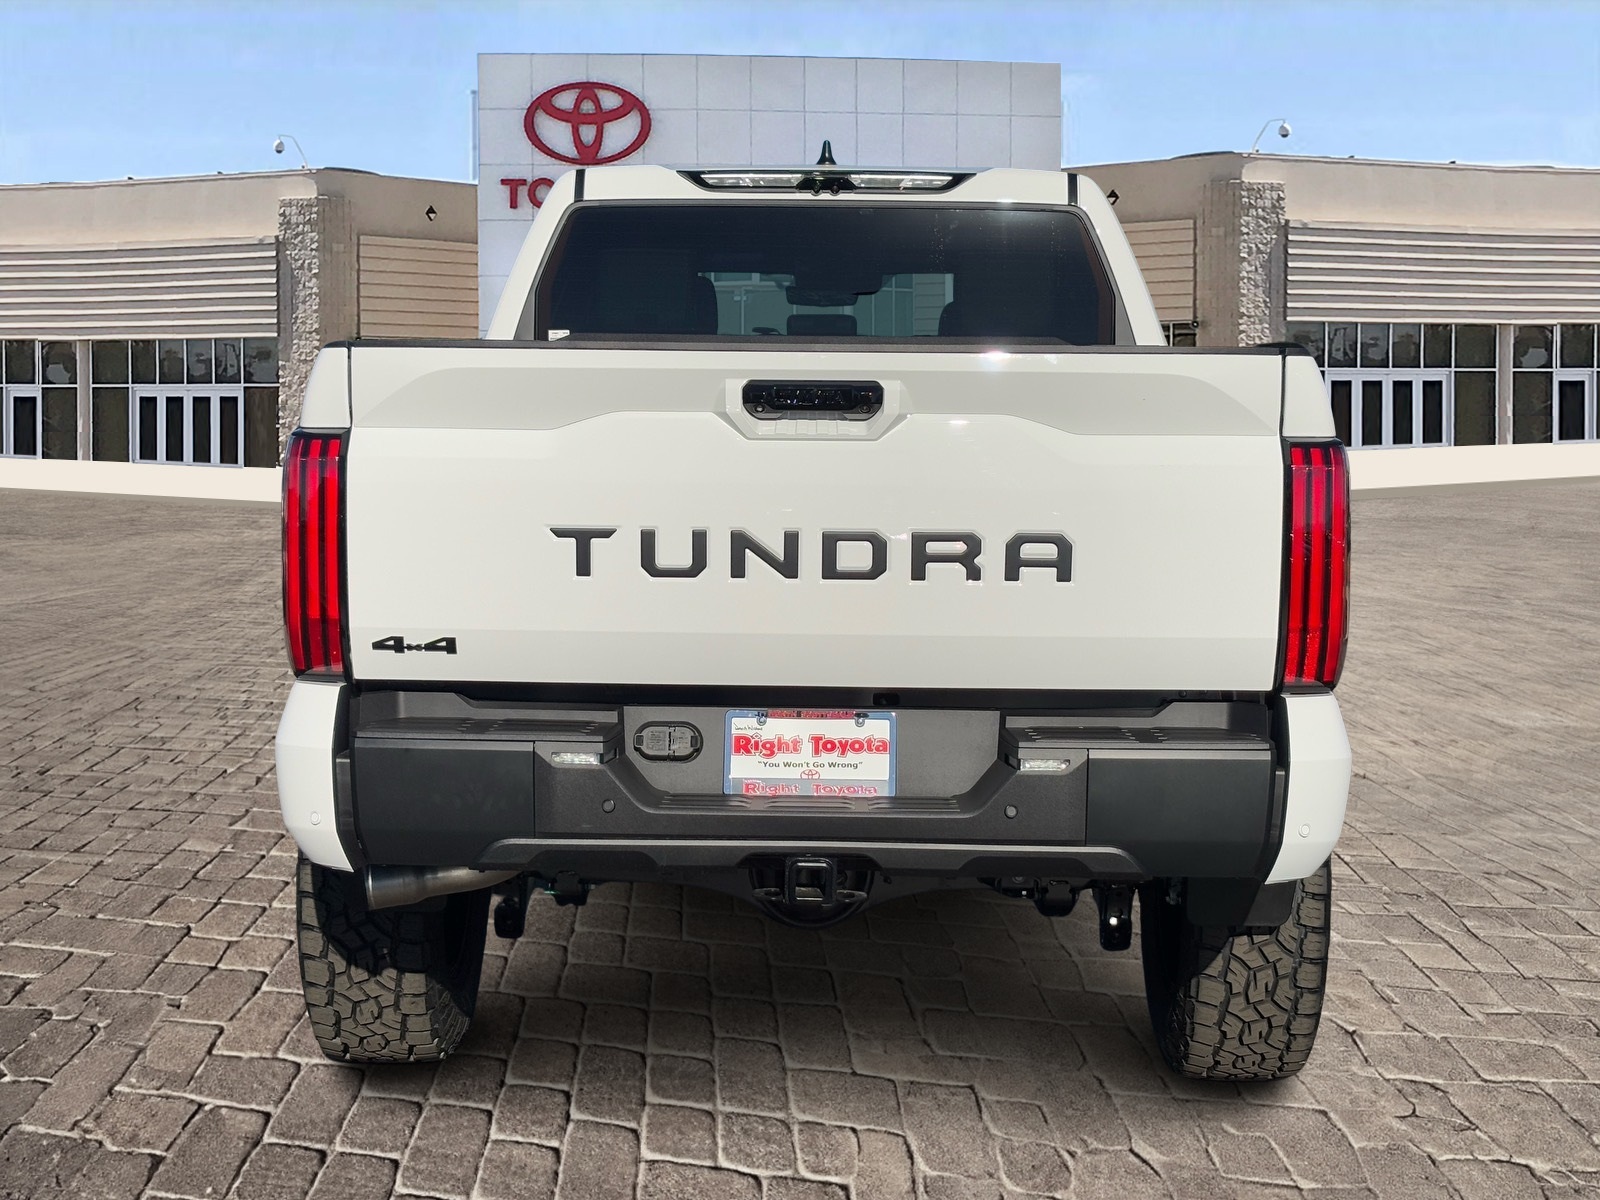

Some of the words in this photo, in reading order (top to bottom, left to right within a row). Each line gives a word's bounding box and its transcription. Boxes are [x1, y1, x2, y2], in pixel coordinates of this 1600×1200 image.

[549, 527, 1074, 583] TUNDRA
[372, 636, 457, 655] 4x4
[732, 733, 803, 759] Right
[809, 734, 890, 758] Toyota
[812, 761, 825, 769] Go
[743, 782, 799, 798] Right
[812, 783, 878, 797] Toyota
